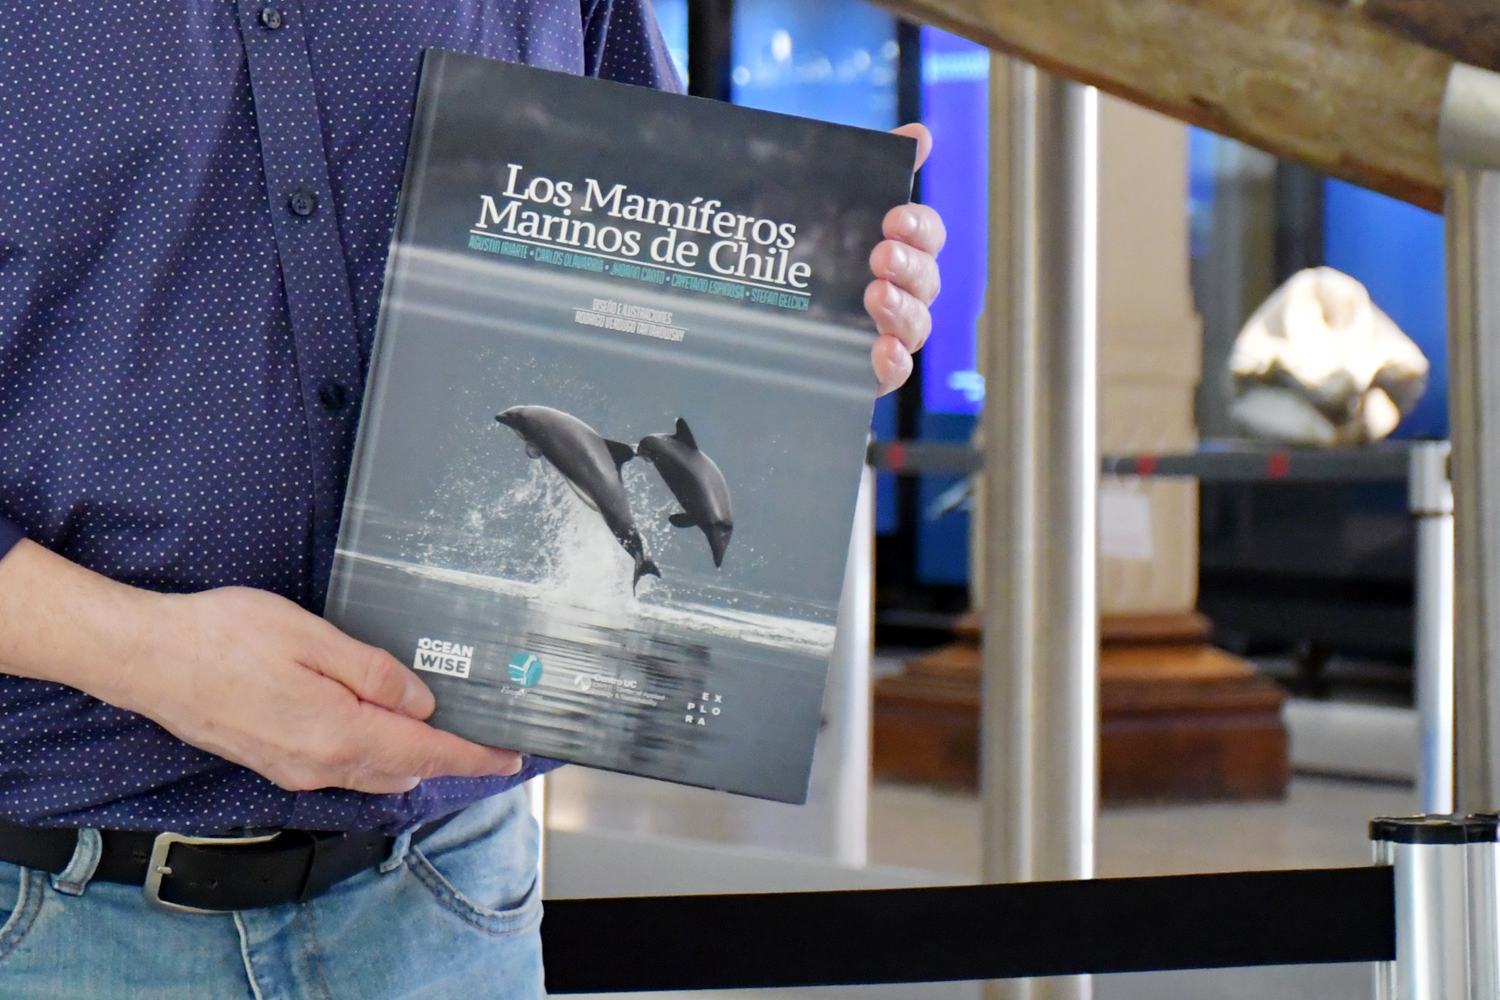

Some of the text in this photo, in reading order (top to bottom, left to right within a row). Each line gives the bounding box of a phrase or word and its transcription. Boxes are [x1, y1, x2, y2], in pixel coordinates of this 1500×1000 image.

[502, 163, 797, 250] Los Mamíferos
[475, 195, 812, 288] Marinos de Chile
[534, 247, 563, 266] CARLOS
[418, 637, 474, 658] OCEAN
[420, 653, 467, 674] WISE
[623, 679, 638, 689] UC
